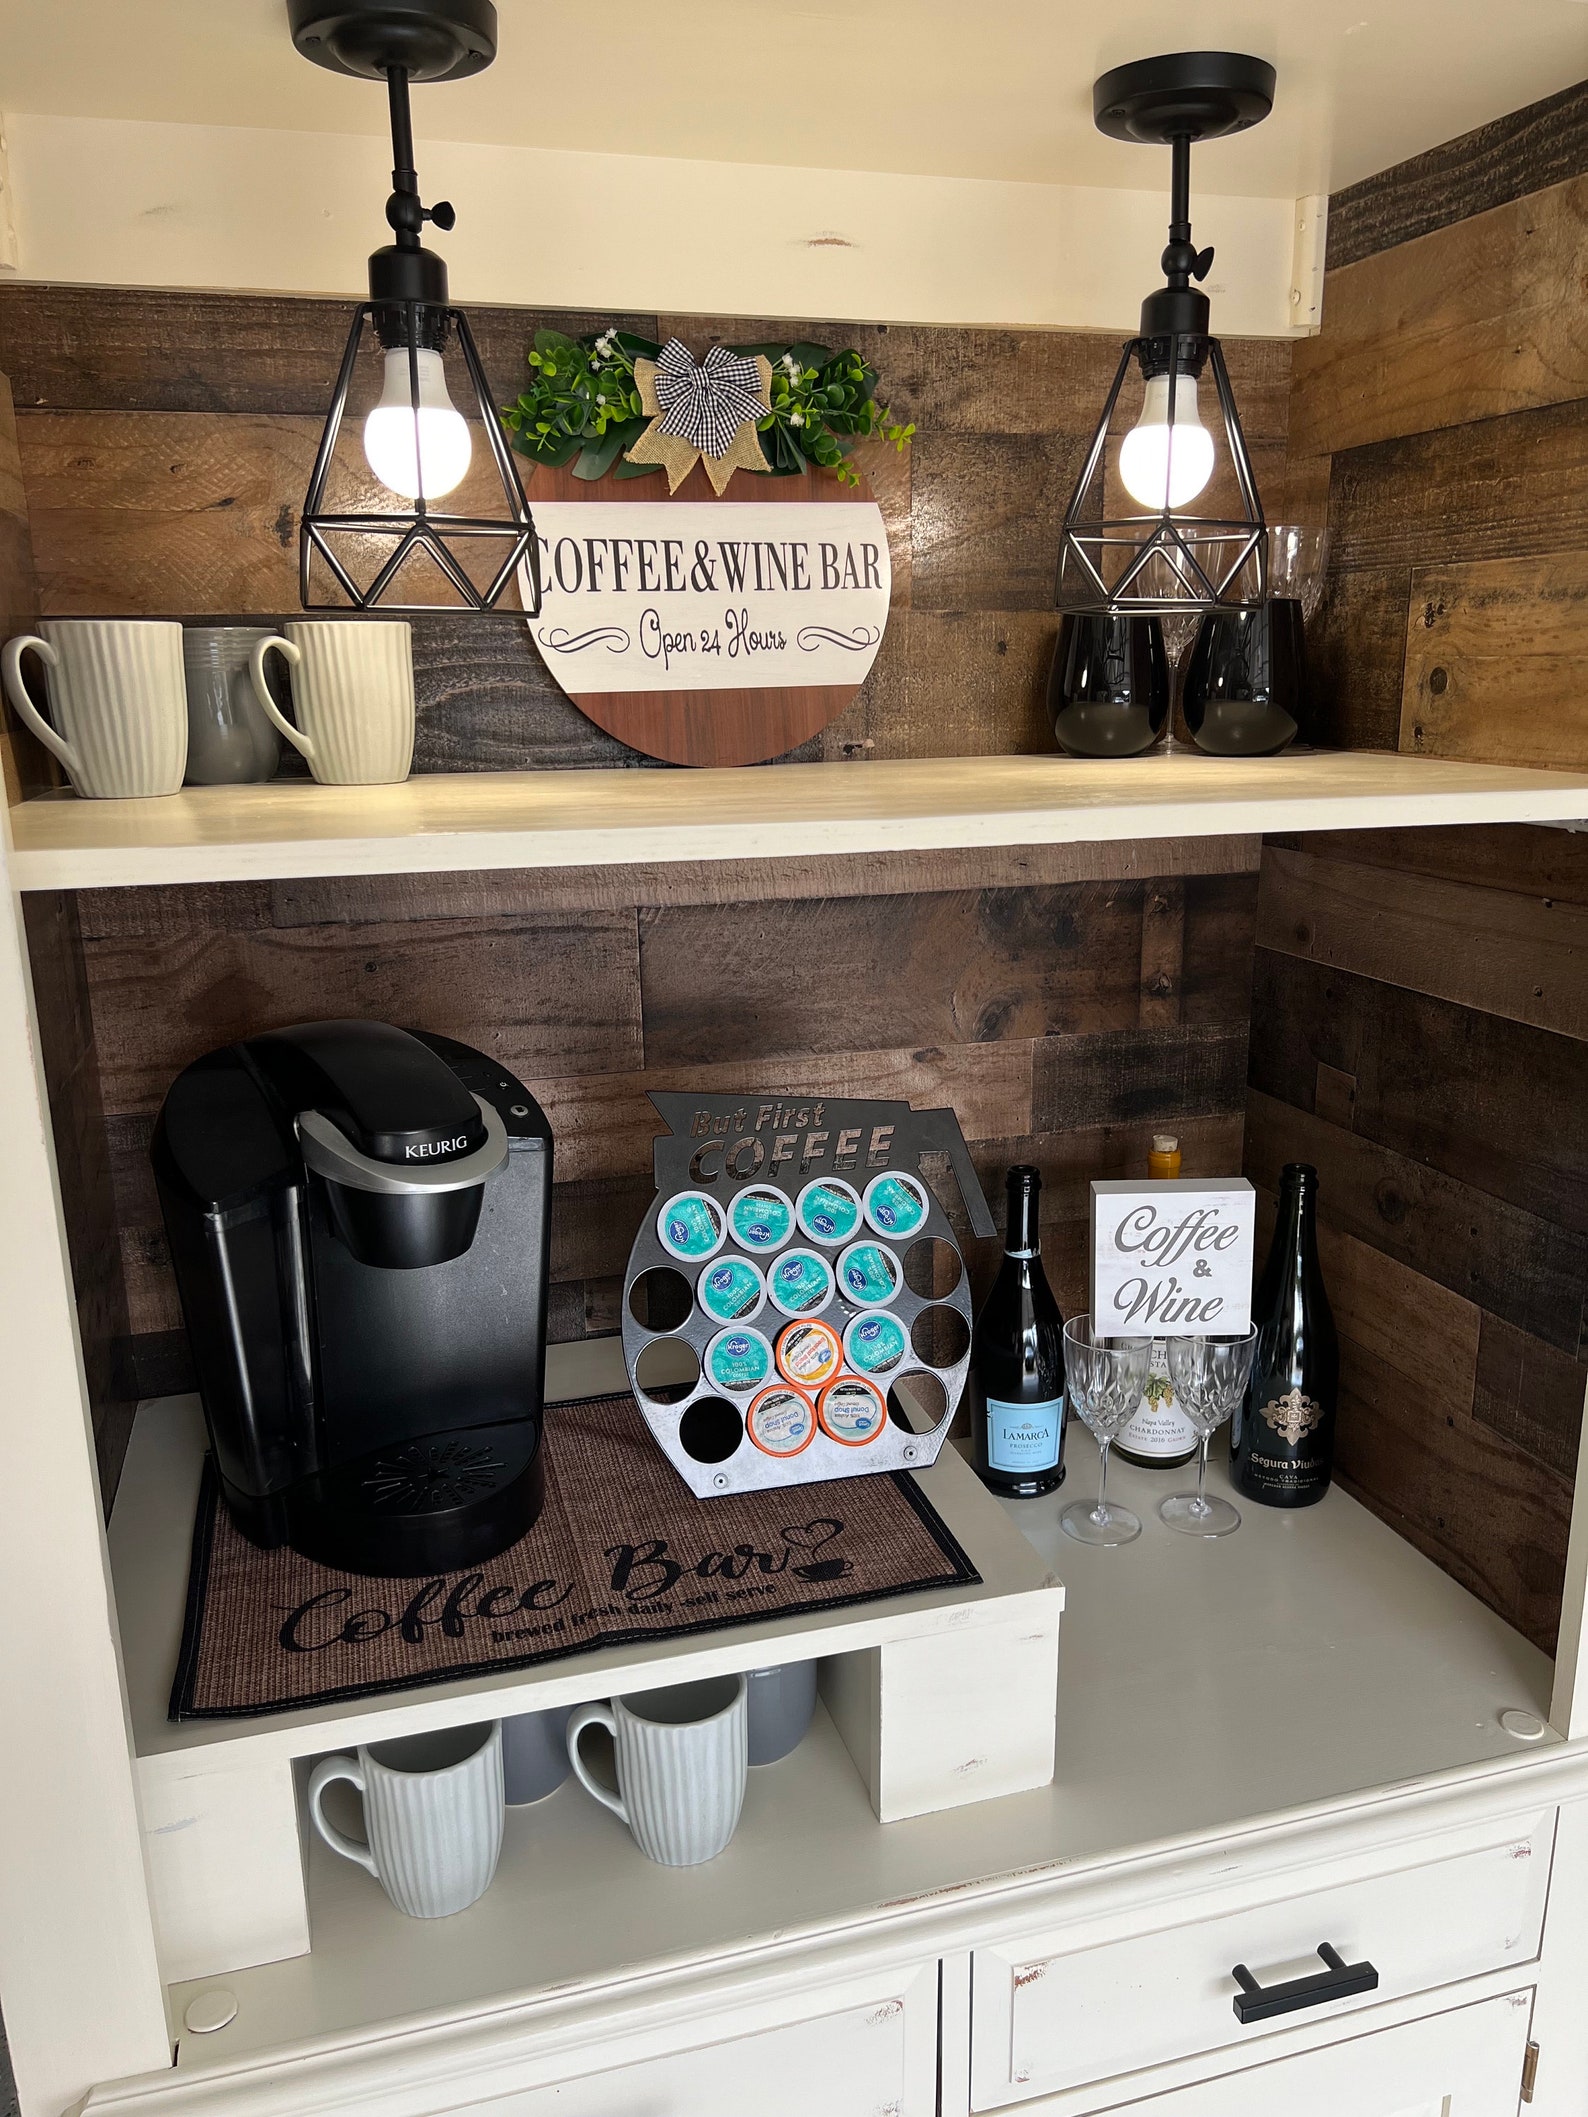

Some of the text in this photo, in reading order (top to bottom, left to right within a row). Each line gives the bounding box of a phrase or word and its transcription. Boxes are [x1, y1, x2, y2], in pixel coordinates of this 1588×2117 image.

[818, 542, 882, 590] BAR
[639, 608, 787, 671] Open 24 Hours
[690, 1102, 826, 1138] But First
[405, 1136, 467, 1159] KEURIG
[688, 1125, 896, 1184] COFFEE
[877, 1207, 894, 1224] Kroger
[673, 1222, 684, 1243] Kroger
[749, 1227, 770, 1240] Kroger
[814, 1218, 834, 1232] Kroger
[1114, 1205, 1239, 1267] Coffee
[783, 1264, 802, 1278] Kroger
[1193, 1259, 1212, 1277] &
[714, 1271, 732, 1288] Kroger
[722, 1282, 754, 1311] COLOMBIAN
[789, 1277, 823, 1302] COLOMBIAN
[1113, 1277, 1224, 1324] Wine
[860, 1324, 879, 1338] Kroger
[728, 1341, 749, 1352] Kroger
[721, 1365, 759, 1374] COLOMBIAN
[764, 1418, 780, 1428] Shop
[780, 1412, 799, 1422] Donut
[1158, 1419, 1175, 1428] Valley
[1129, 1424, 1185, 1434] CHARDONNAY
[1251, 1452, 1288, 1469] Segura
[270, 1540, 790, 1652] Coffee Bar
[491, 1618, 565, 1643] brewed
[571, 1603, 621, 1627] fresh
[627, 1601, 673, 1615] daily
[725, 1584, 777, 1600] serve
